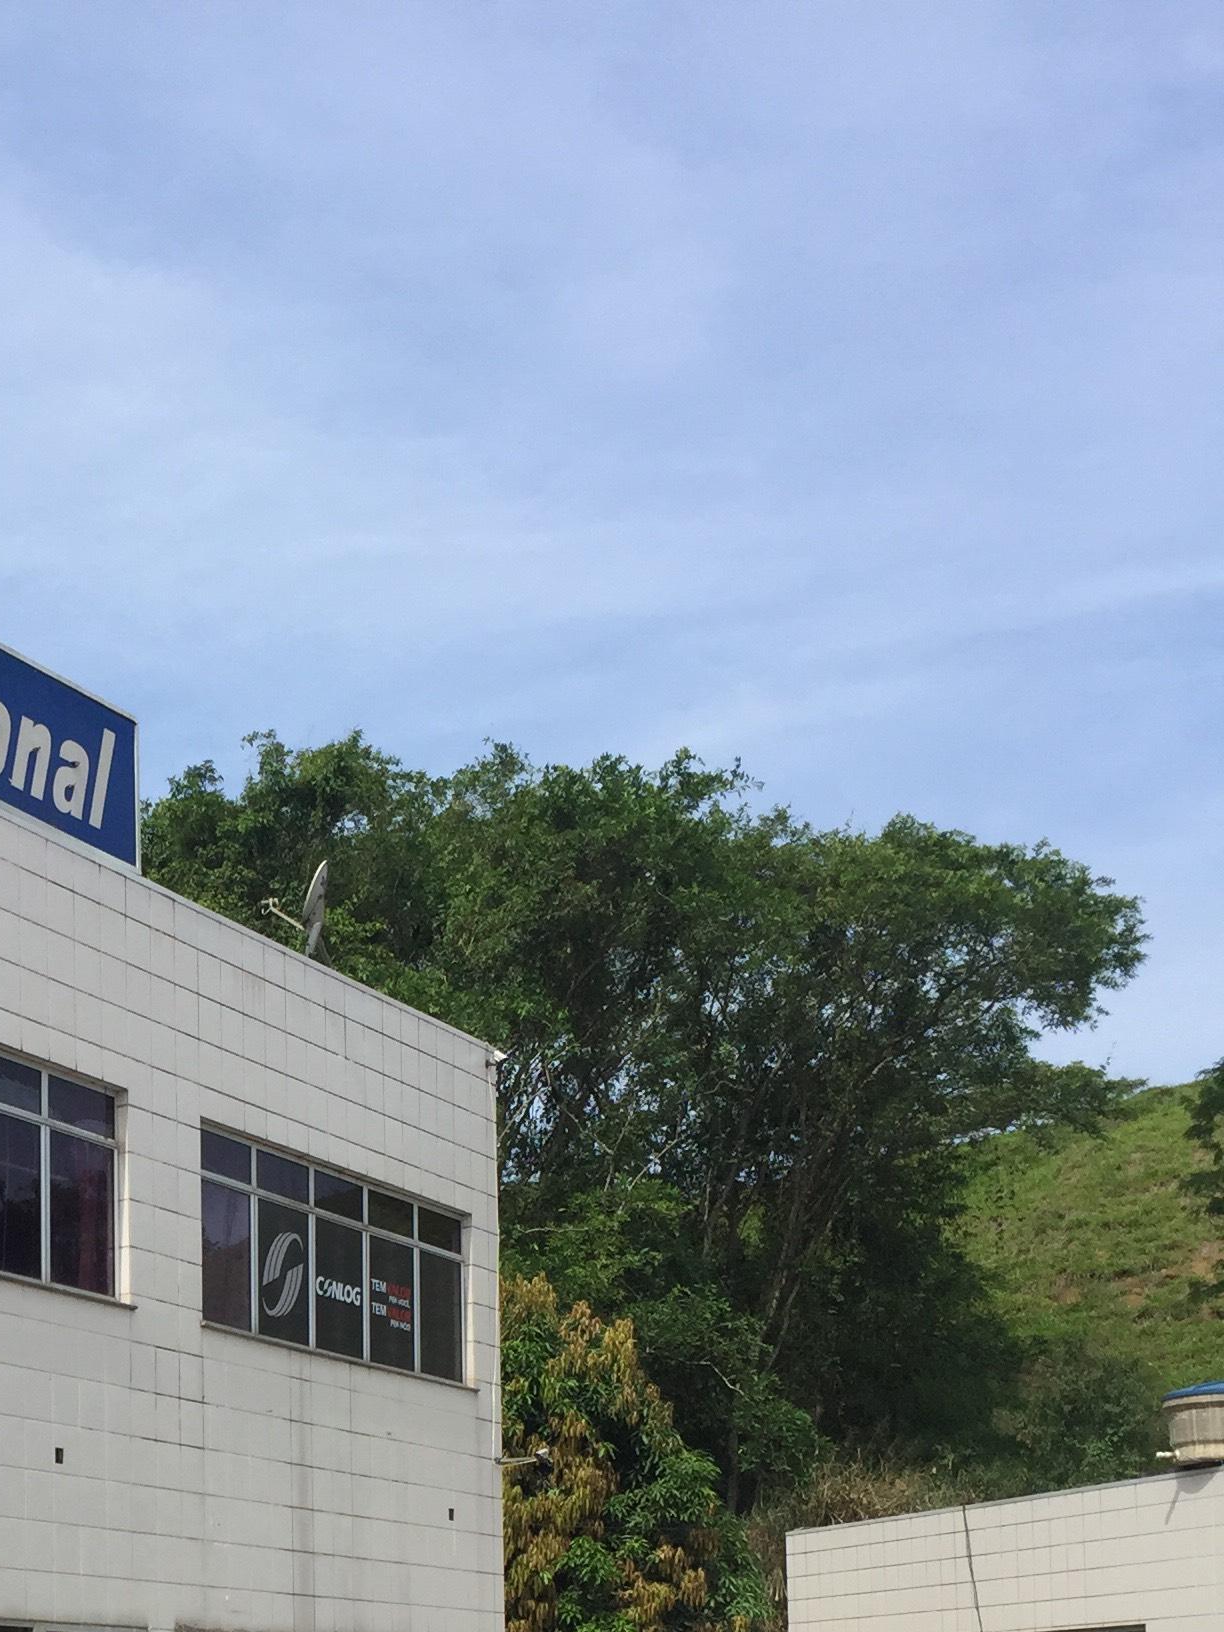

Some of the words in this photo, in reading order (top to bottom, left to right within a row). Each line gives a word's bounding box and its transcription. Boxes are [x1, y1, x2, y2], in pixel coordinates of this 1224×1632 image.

[316, 1276, 361, 1306] CONLOG
[371, 1278, 387, 1293] TEM
[371, 1302, 387, 1317] TEM
